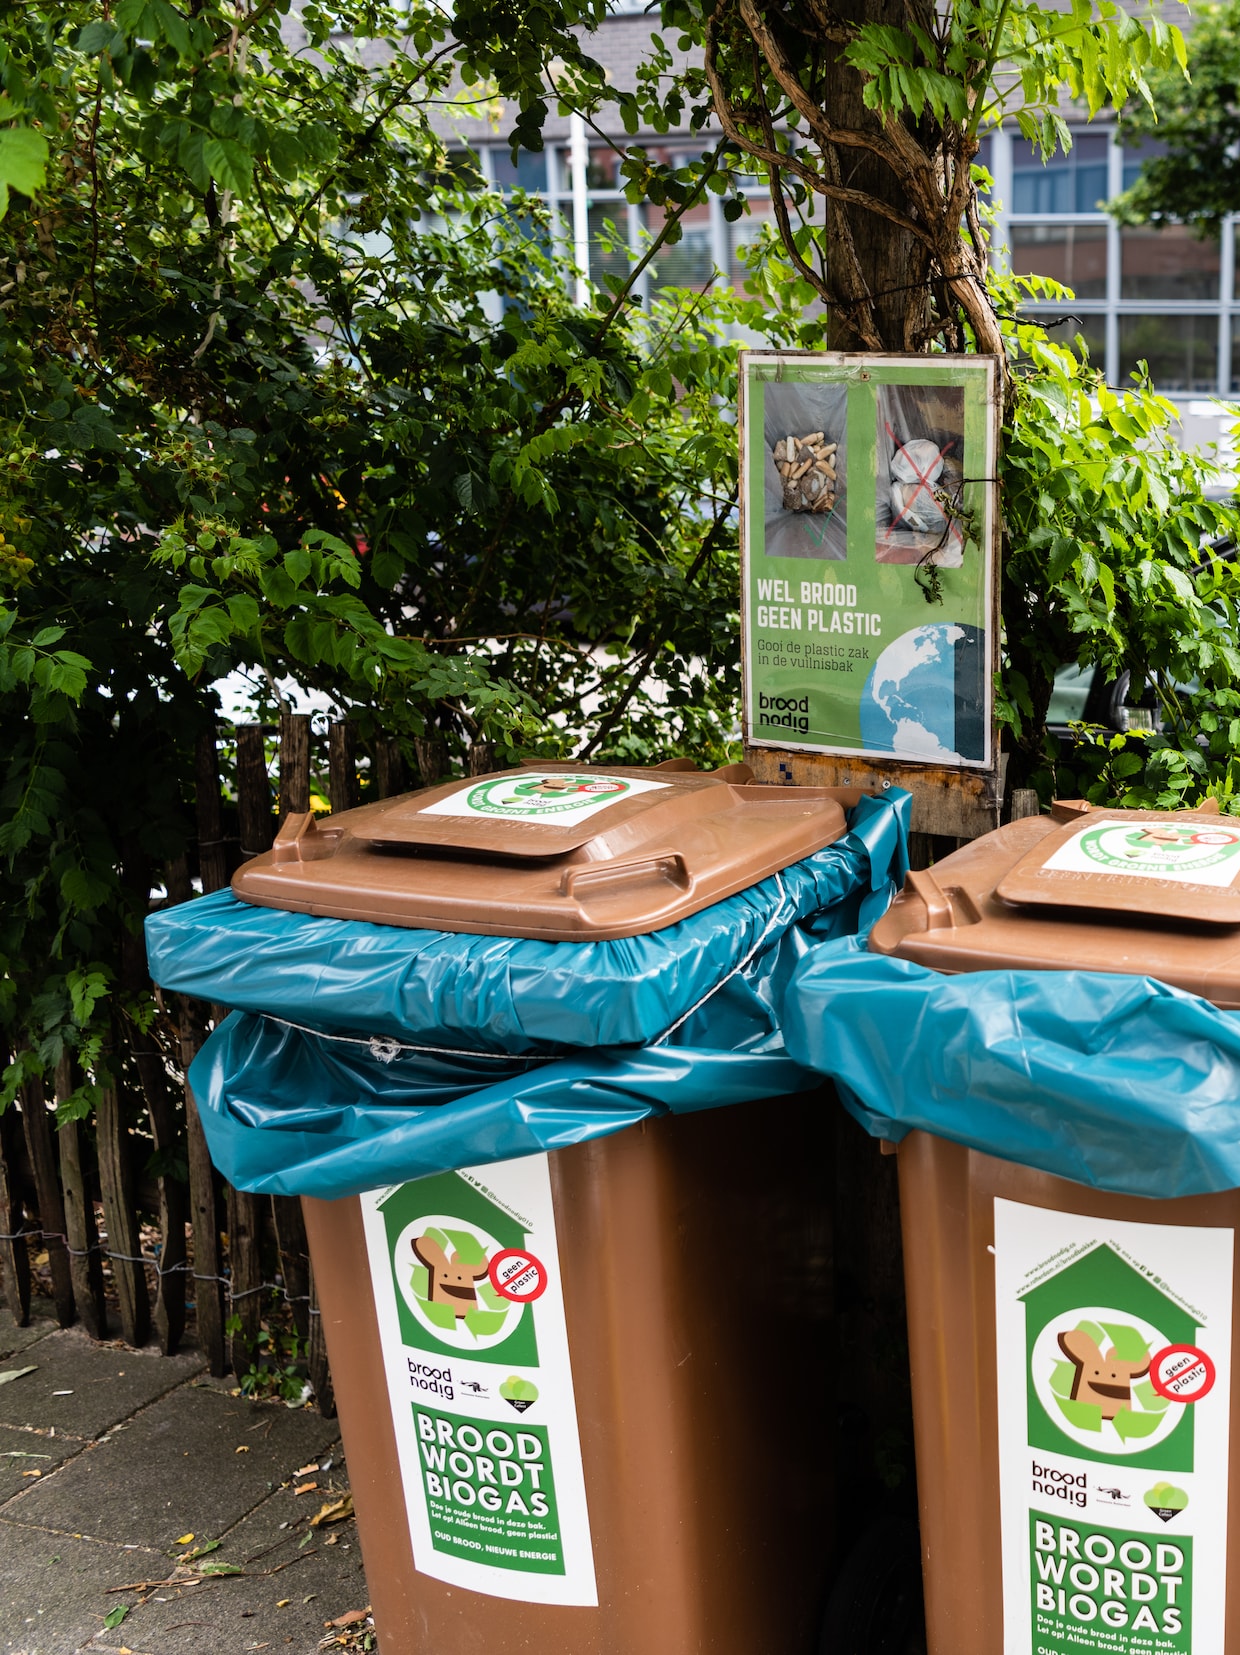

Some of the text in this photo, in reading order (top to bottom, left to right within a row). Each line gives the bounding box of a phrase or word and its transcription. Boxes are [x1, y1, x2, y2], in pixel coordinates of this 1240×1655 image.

[757, 578, 856, 607] WEL BROOD
[758, 606, 882, 636] GEEN PLASTIC
[758, 639, 869, 658] Gooi de plastic zak
[758, 654, 853, 672] in de vuilnisbak
[759, 692, 808, 713] brood
[481, 806, 530, 814] GROENE
[1108, 859, 1166, 871] GROENE
[487, 1191, 534, 1227] @broodnodig010
[502, 1260, 524, 1278] geen
[510, 1268, 538, 1293] plastic
[407, 1358, 452, 1382] brood
[1165, 1356, 1190, 1377] geen
[1172, 1365, 1206, 1393] plastic
[417, 1412, 542, 1460] BROOD
[420, 1442, 544, 1489] WORDT
[1032, 1460, 1086, 1488] brood
[426, 1471, 550, 1518] BIOGAS
[430, 1500, 546, 1530] Doe je oude brood in deze bak.
[432, 1510, 558, 1540] Let op! Alleen brood, geen plastic!
[434, 1530, 556, 1560] OUD BROOD, NIEUWE ENERGIE
[1036, 1520, 1184, 1574] BROOD
[1035, 1551, 1182, 1604] WORDT
[1036, 1582, 1182, 1634] BIOGAS
[1036, 1614, 1176, 1648] Doe je oude brood in deze bak.
[1037, 1624, 1049, 1634] Let
[1052, 1630, 1064, 1640] op!
[1067, 1634, 1095, 1646] Alleen
[1098, 1641, 1126, 1653] brood,
[1130, 1647, 1152, 1655] geen
